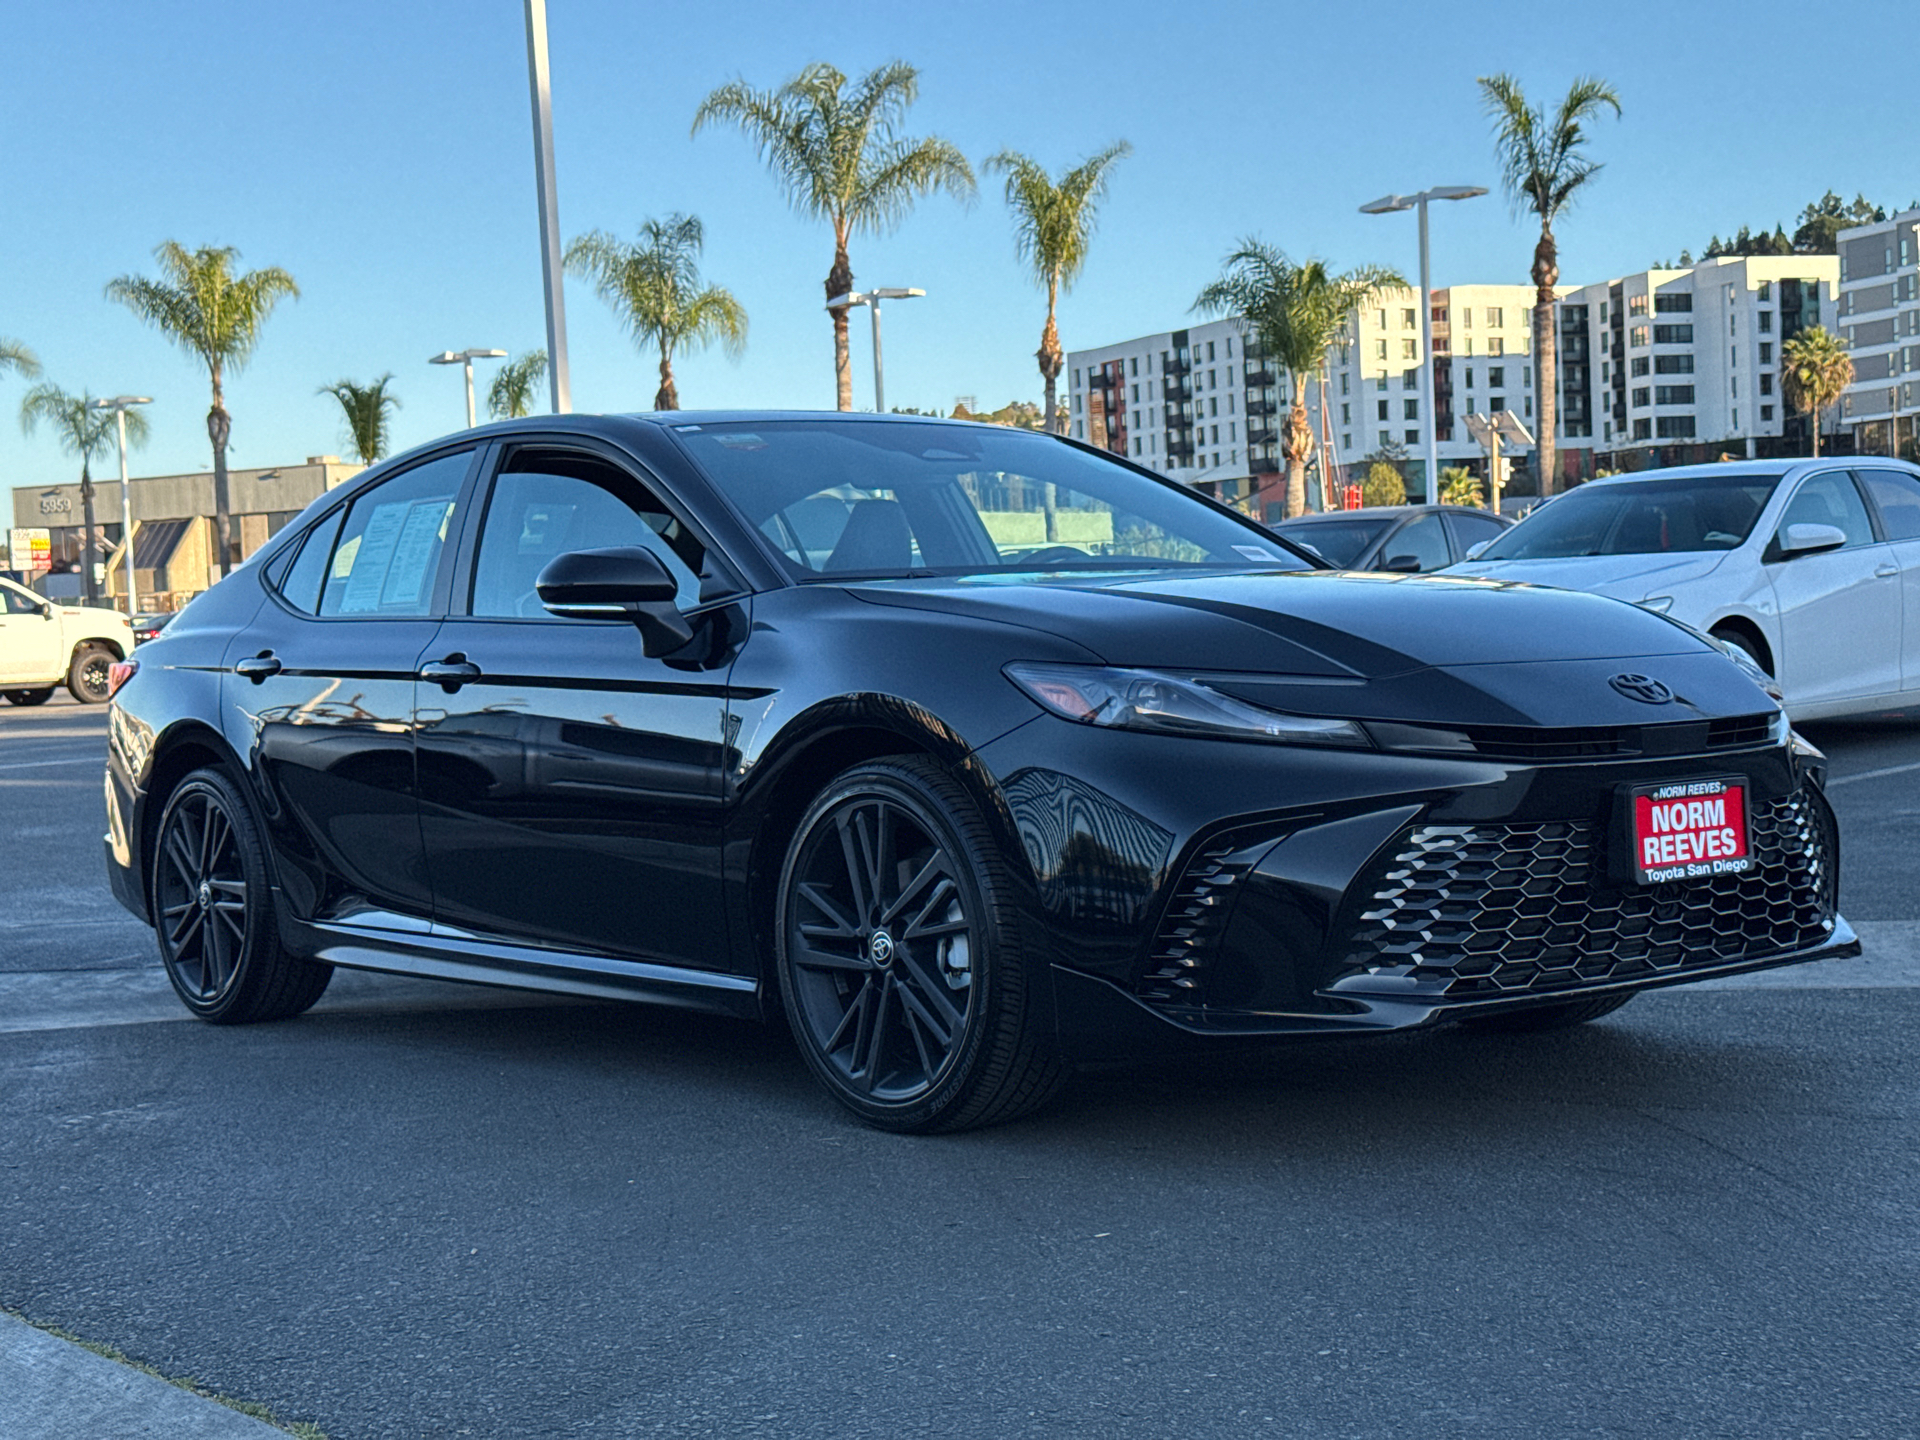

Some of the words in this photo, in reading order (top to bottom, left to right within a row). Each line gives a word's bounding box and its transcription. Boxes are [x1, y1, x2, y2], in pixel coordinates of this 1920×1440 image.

[42, 498, 71, 513] 5959
[1659, 785, 1686, 799] NORM
[1687, 781, 1721, 796] REEVES
[1651, 799, 1726, 833] NORM
[1643, 827, 1737, 865] REEVES
[1645, 867, 1685, 883] Toyota
[1687, 863, 1711, 876] San
[1713, 859, 1748, 874] Diego
